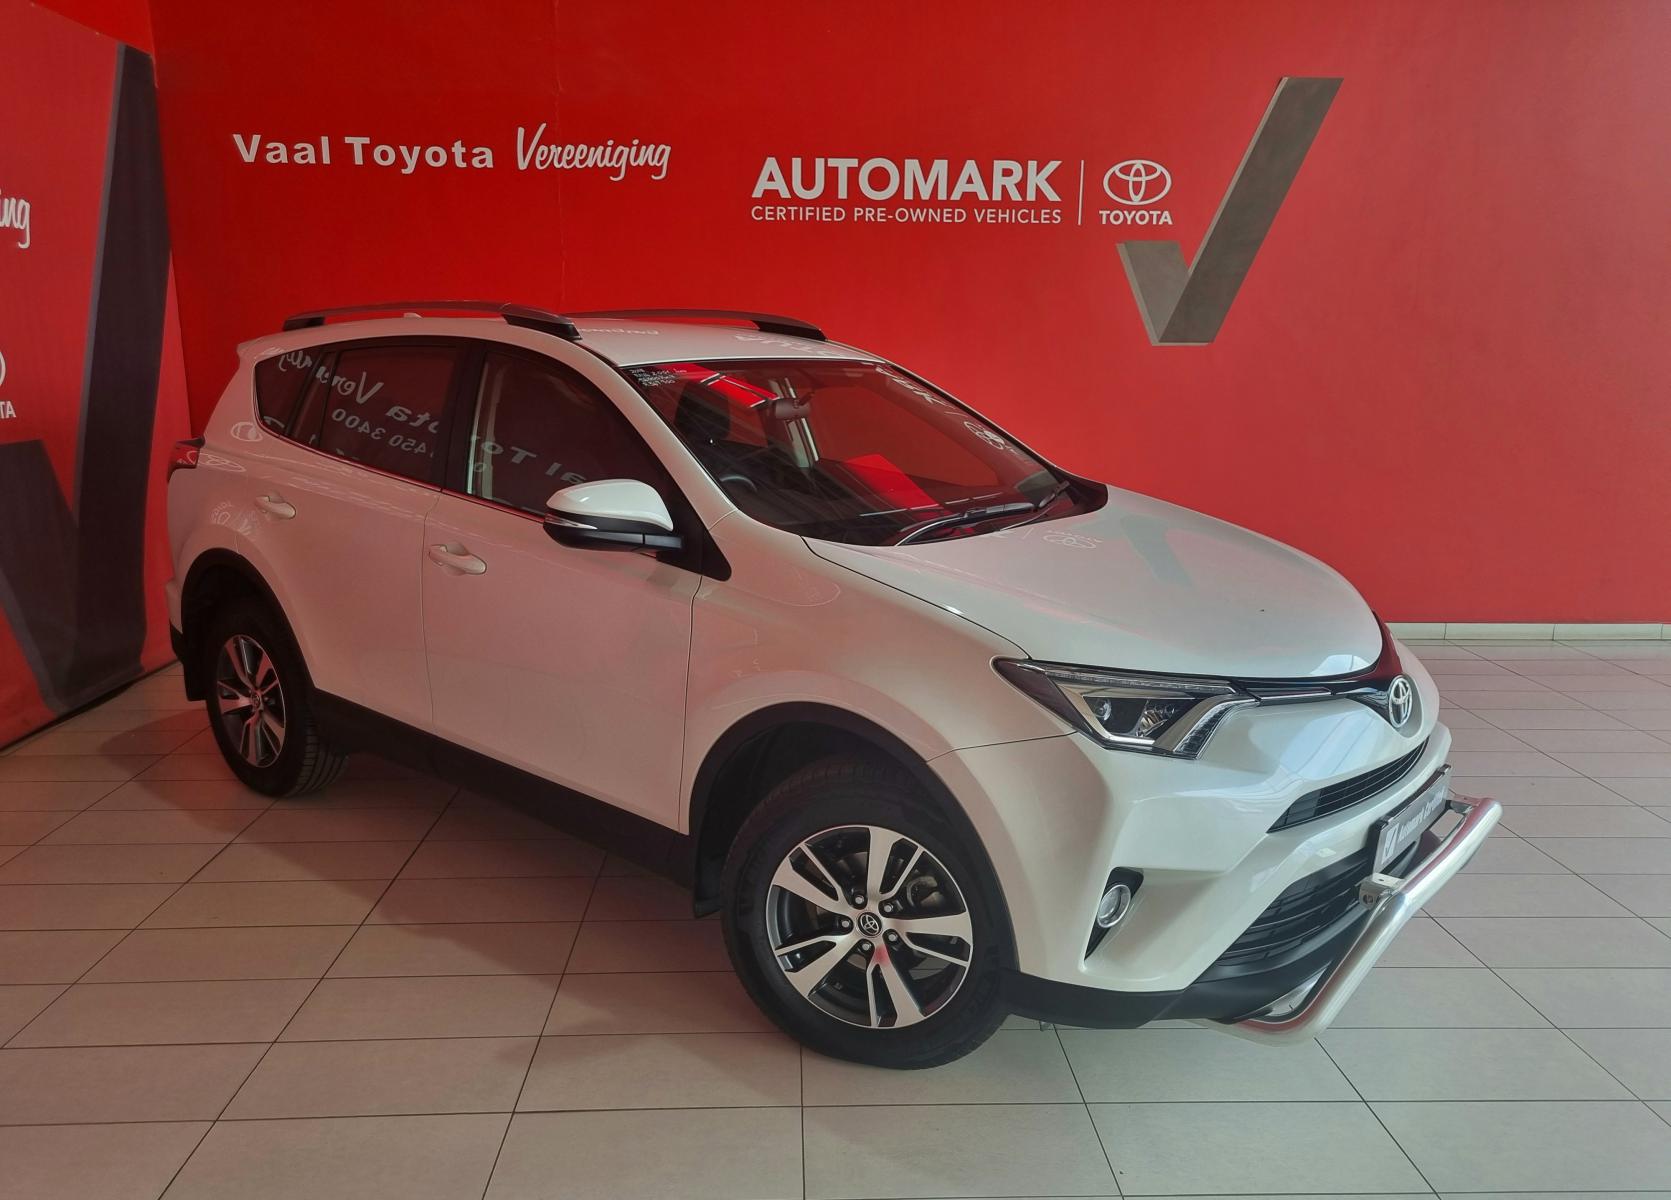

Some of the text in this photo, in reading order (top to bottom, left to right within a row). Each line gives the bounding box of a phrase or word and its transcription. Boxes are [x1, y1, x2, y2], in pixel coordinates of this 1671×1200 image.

[232, 122, 672, 182] Vaal Toyota Vereeniging
[751, 156, 1063, 202] AUTOMARK
[751, 205, 1062, 224] CERTIFIED PRE-OWNED VEHICLES
[1098, 209, 1173, 226] TOYOTA
